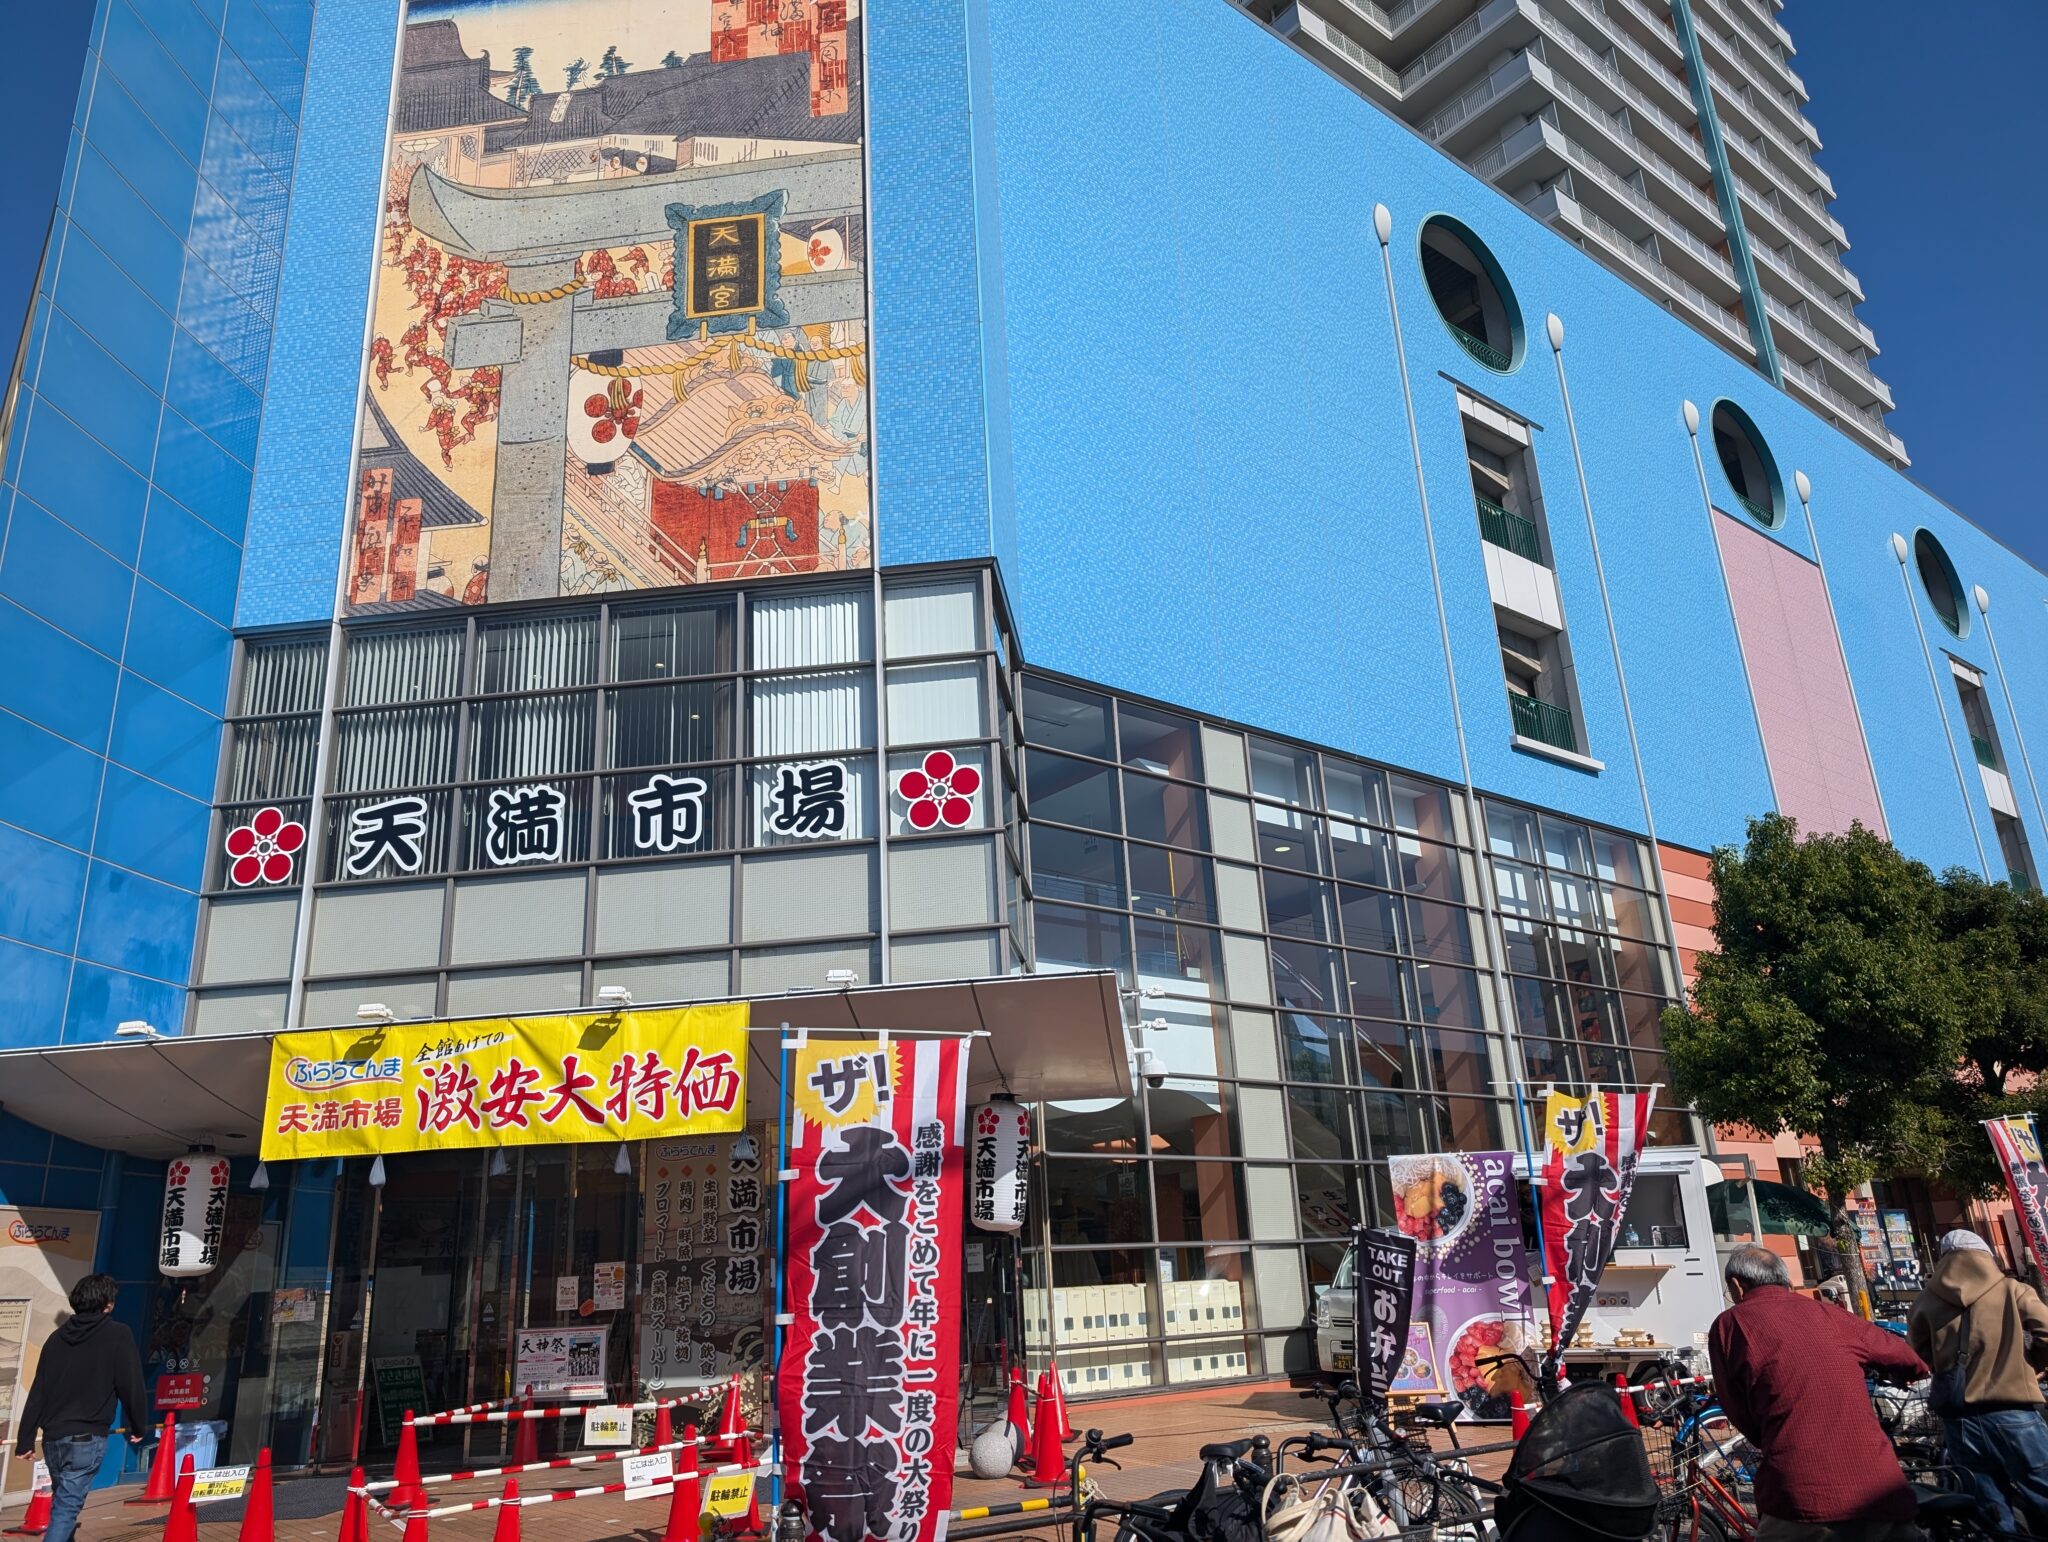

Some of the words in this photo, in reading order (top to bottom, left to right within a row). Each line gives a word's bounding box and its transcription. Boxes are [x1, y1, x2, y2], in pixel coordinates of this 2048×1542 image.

[708, 224, 741, 308] 天満宮
[347, 759, 850, 876] 天満市場
[293, 1057, 402, 1084] ぷららてんま
[415, 1031, 505, 1062] 全館あげての
[278, 1097, 402, 1134] 天満市場
[416, 1047, 742, 1134] 激安大特価
[660, 1144, 717, 1157] ぷららてんま
[975, 1136, 998, 1221] 天満市場
[1011, 1139, 1029, 1222] 天満市場
[1483, 1158, 1518, 1228] acai
[13, 1224, 71, 1240] ぷららてんま
[160, 1187, 187, 1267] 天満市場
[198, 1186, 227, 1266] 天満市場
[1367, 1246, 1409, 1269] TAKE
[1372, 1264, 1403, 1284] OUT
[1491, 1236, 1532, 1323] bowl
[700, 1178, 720, 1401] 生鮮野菜・くだもの・飲食
[519, 1337, 567, 1355] 天神祭
[801, 1125, 912, 1542] 大創業祭
[898, 1121, 943, 1542] 感謝をこめて年に一度の大祭り
[1369, 1288, 1398, 1399] お弁当
[590, 1420, 628, 1433] 駐輪禁止
[198, 1468, 247, 1479] ここは出入口
[629, 1456, 668, 1470] ここは出入口
[192, 1486, 242, 1498] 自転車止めるな
[709, 1487, 749, 1503] 駐輪禁止
